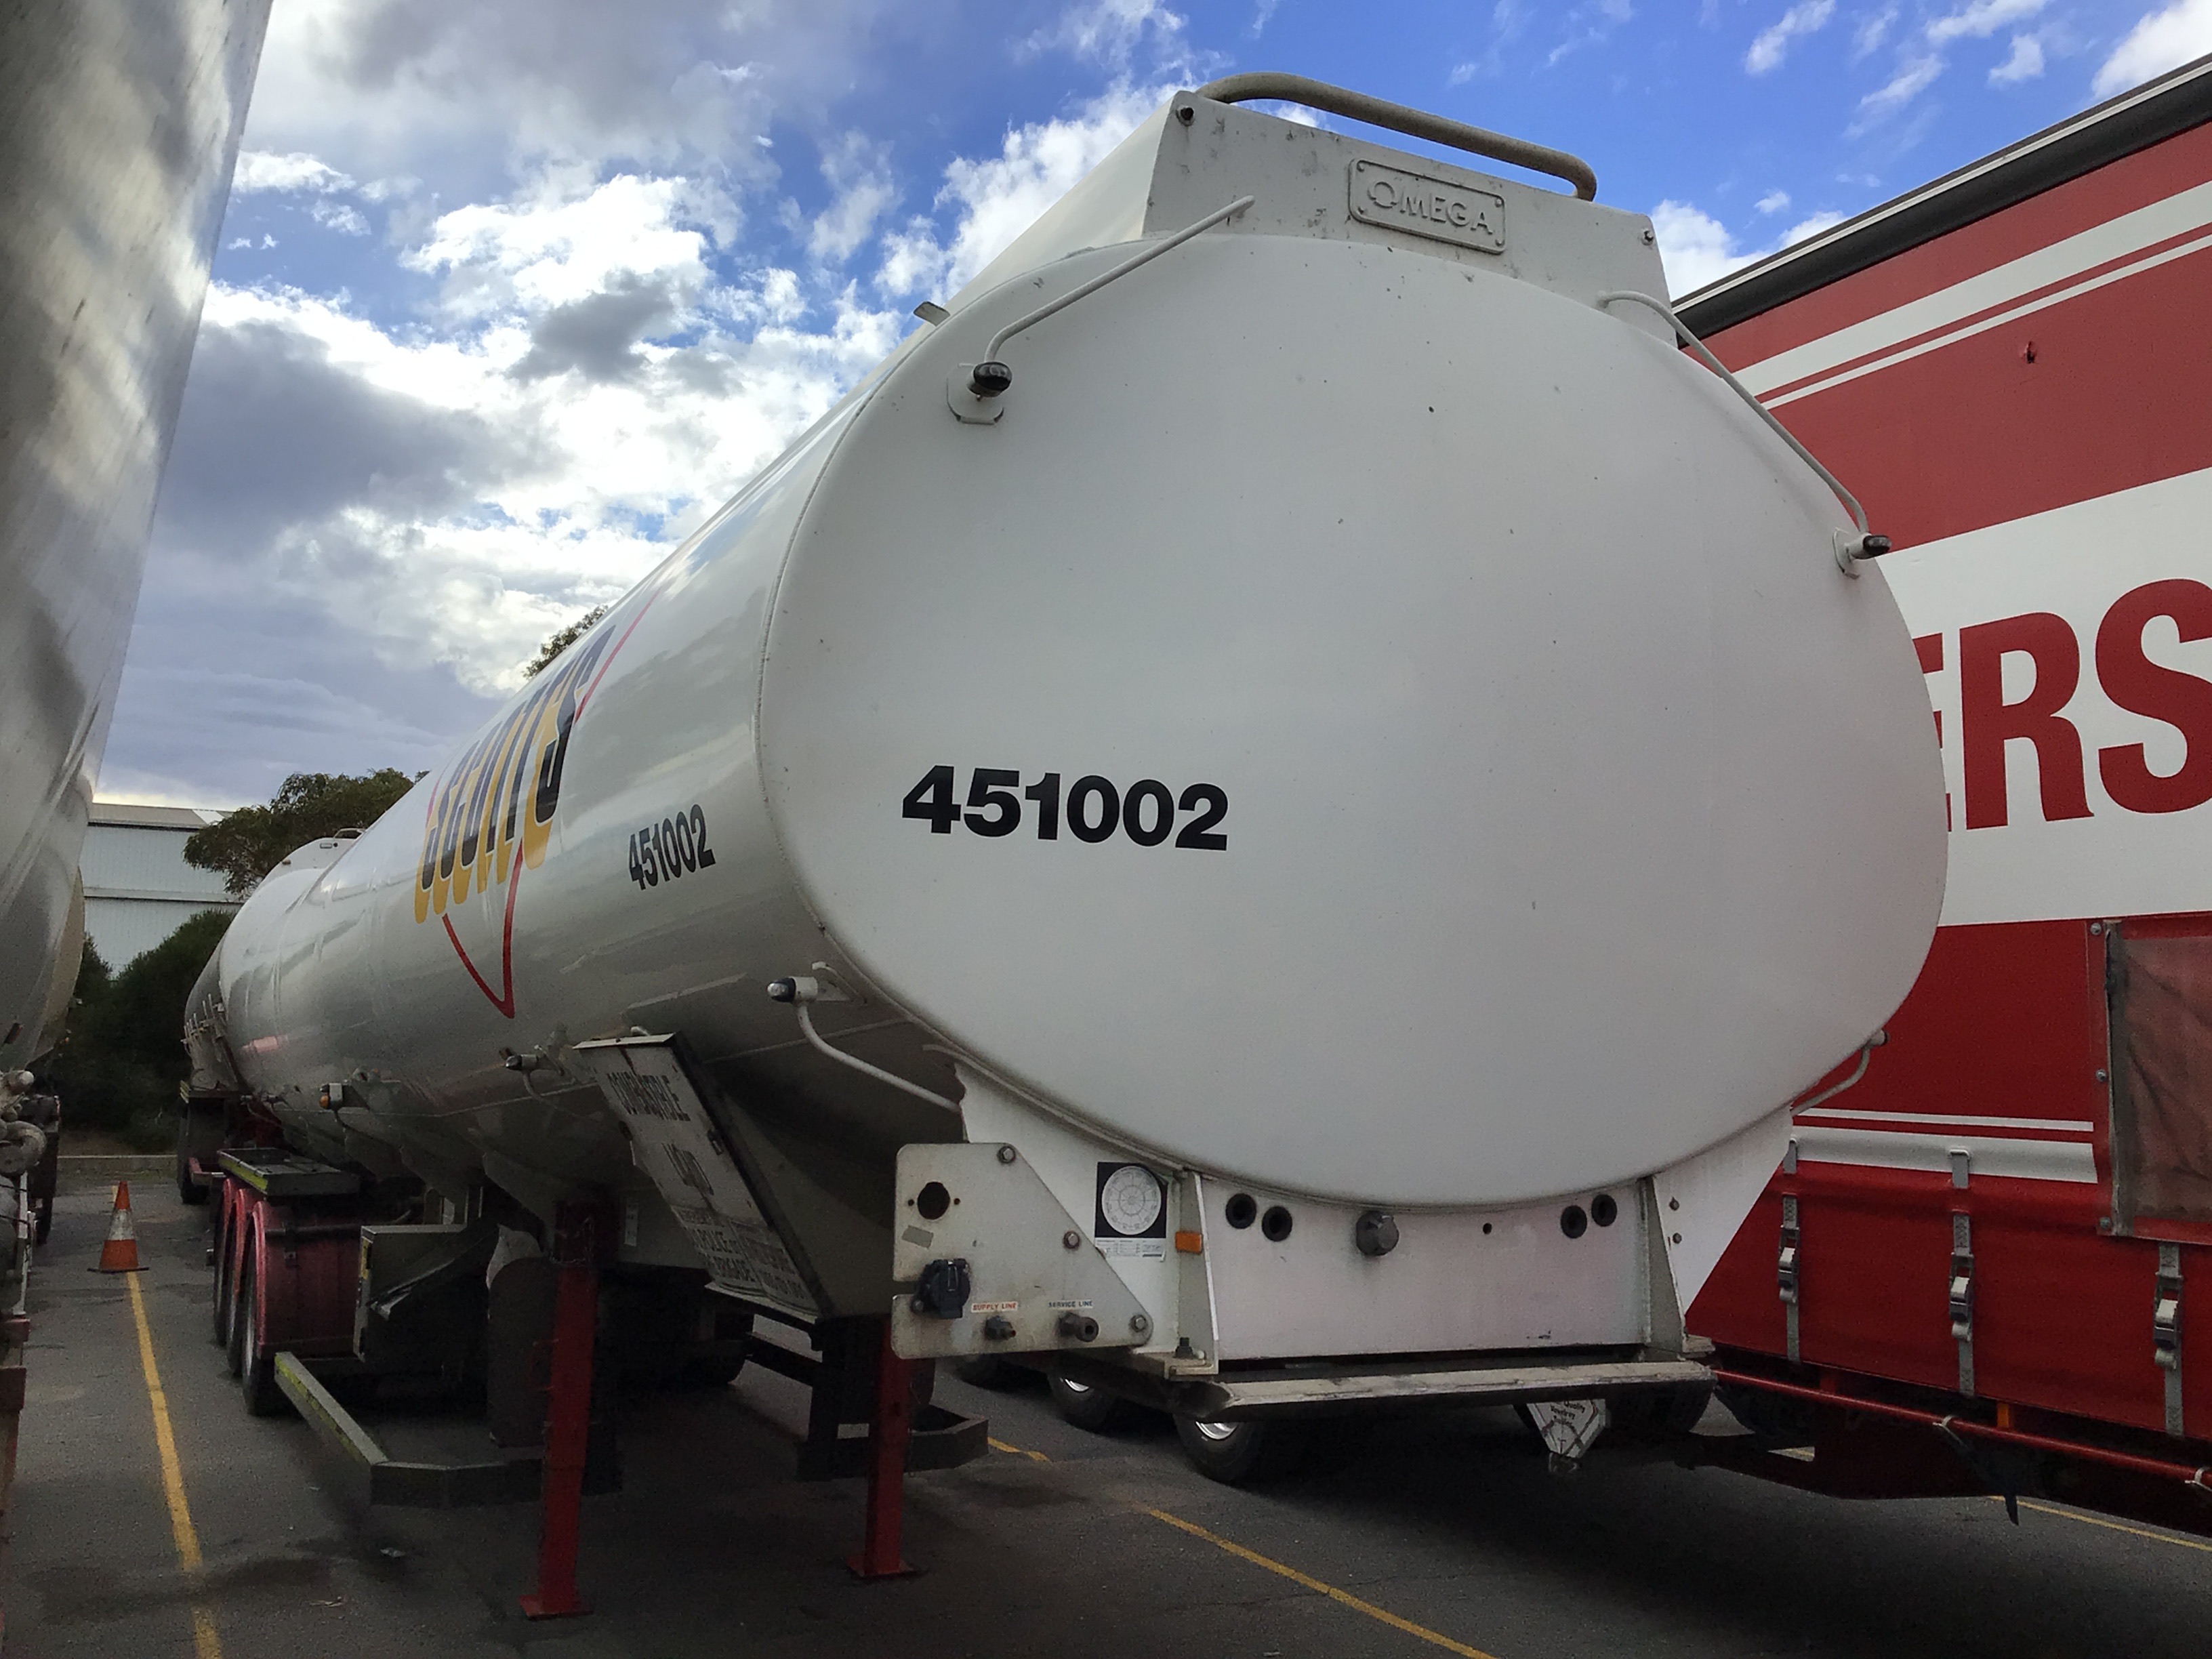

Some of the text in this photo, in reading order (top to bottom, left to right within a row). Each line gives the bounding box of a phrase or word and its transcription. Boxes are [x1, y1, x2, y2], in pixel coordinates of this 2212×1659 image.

[1367, 181, 1493, 234] OMEGA
[629, 804, 716, 891] 451002
[902, 765, 1229, 851] 451002
